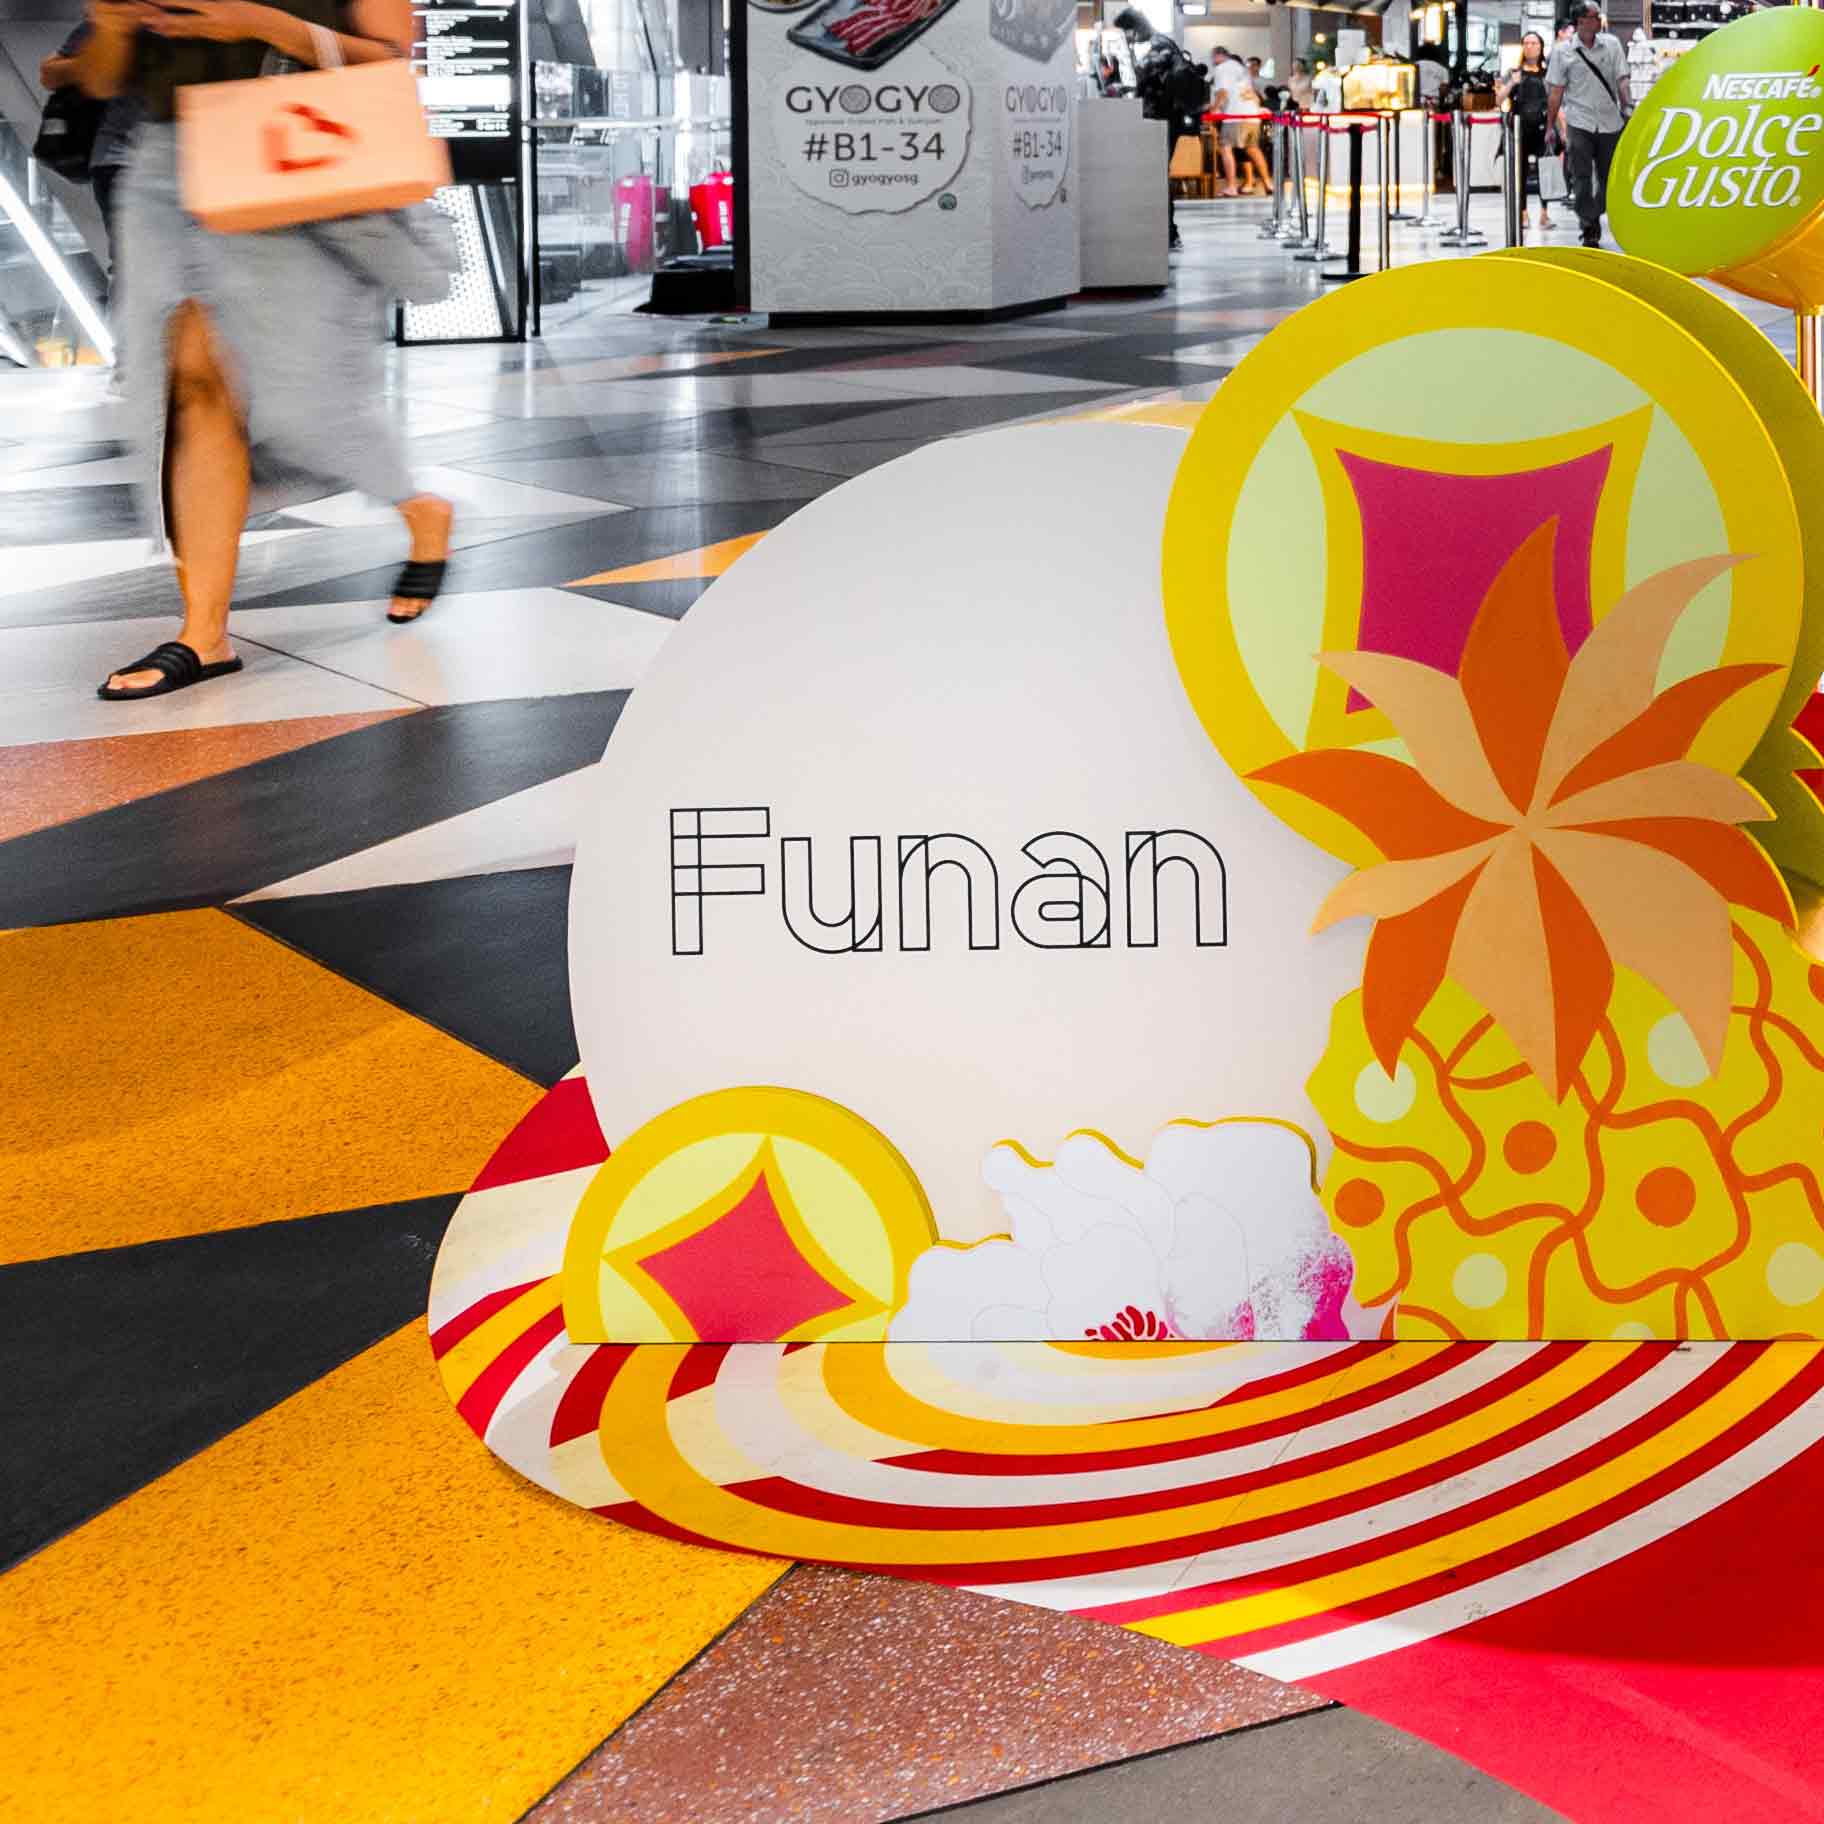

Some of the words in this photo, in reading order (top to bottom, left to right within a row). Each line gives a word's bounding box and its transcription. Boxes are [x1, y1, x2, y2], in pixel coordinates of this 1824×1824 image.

[785, 84, 960, 114] GYOGYO
[803, 132, 945, 161] #B1-34
[1013, 129, 1063, 159] #B1-34
[1648, 105, 1823, 161] Dolce
[851, 172, 919, 186] gyogyosg
[1632, 154, 1800, 209] Gusto
[670, 806, 1228, 956] Funan
